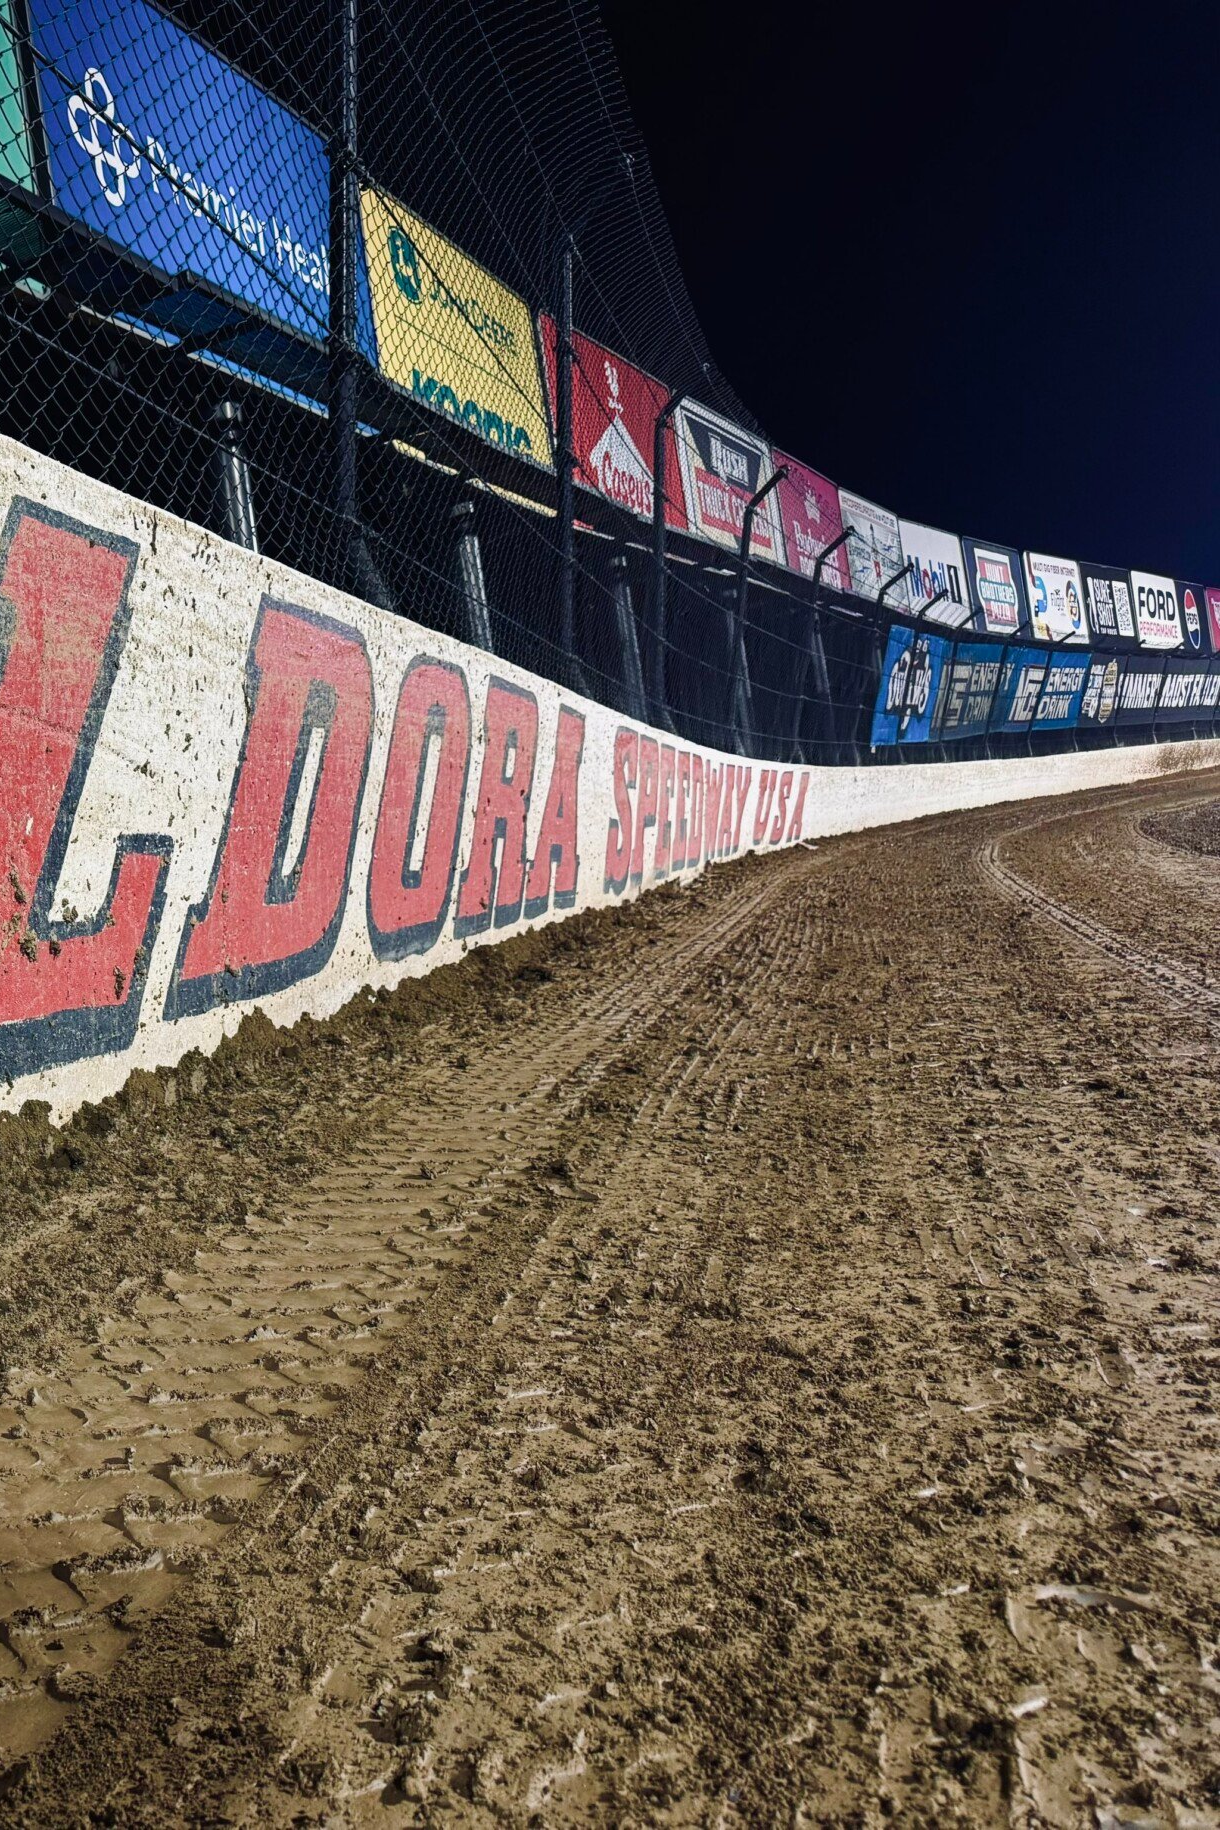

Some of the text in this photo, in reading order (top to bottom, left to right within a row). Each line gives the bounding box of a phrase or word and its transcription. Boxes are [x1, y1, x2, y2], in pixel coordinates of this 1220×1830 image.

[147, 135, 329, 297] Premier Heal
[708, 432, 750, 490] RUSH
[907, 554, 949, 602] Mobil
[980, 580, 1015, 605] BROTHERS
[1093, 578, 1113, 604] SURE
[1097, 602, 1116, 627] SHOT
[1138, 585, 1176, 621] FORD
[1139, 621, 1178, 639] PERFORMANCE
[1045, 667, 1087, 693] ENERGY
[964, 694, 993, 725] DRIN
[1036, 694, 1074, 721] DRINK
[603, 725, 753, 897] SPEEDWAY
[752, 768, 811, 846] USA
